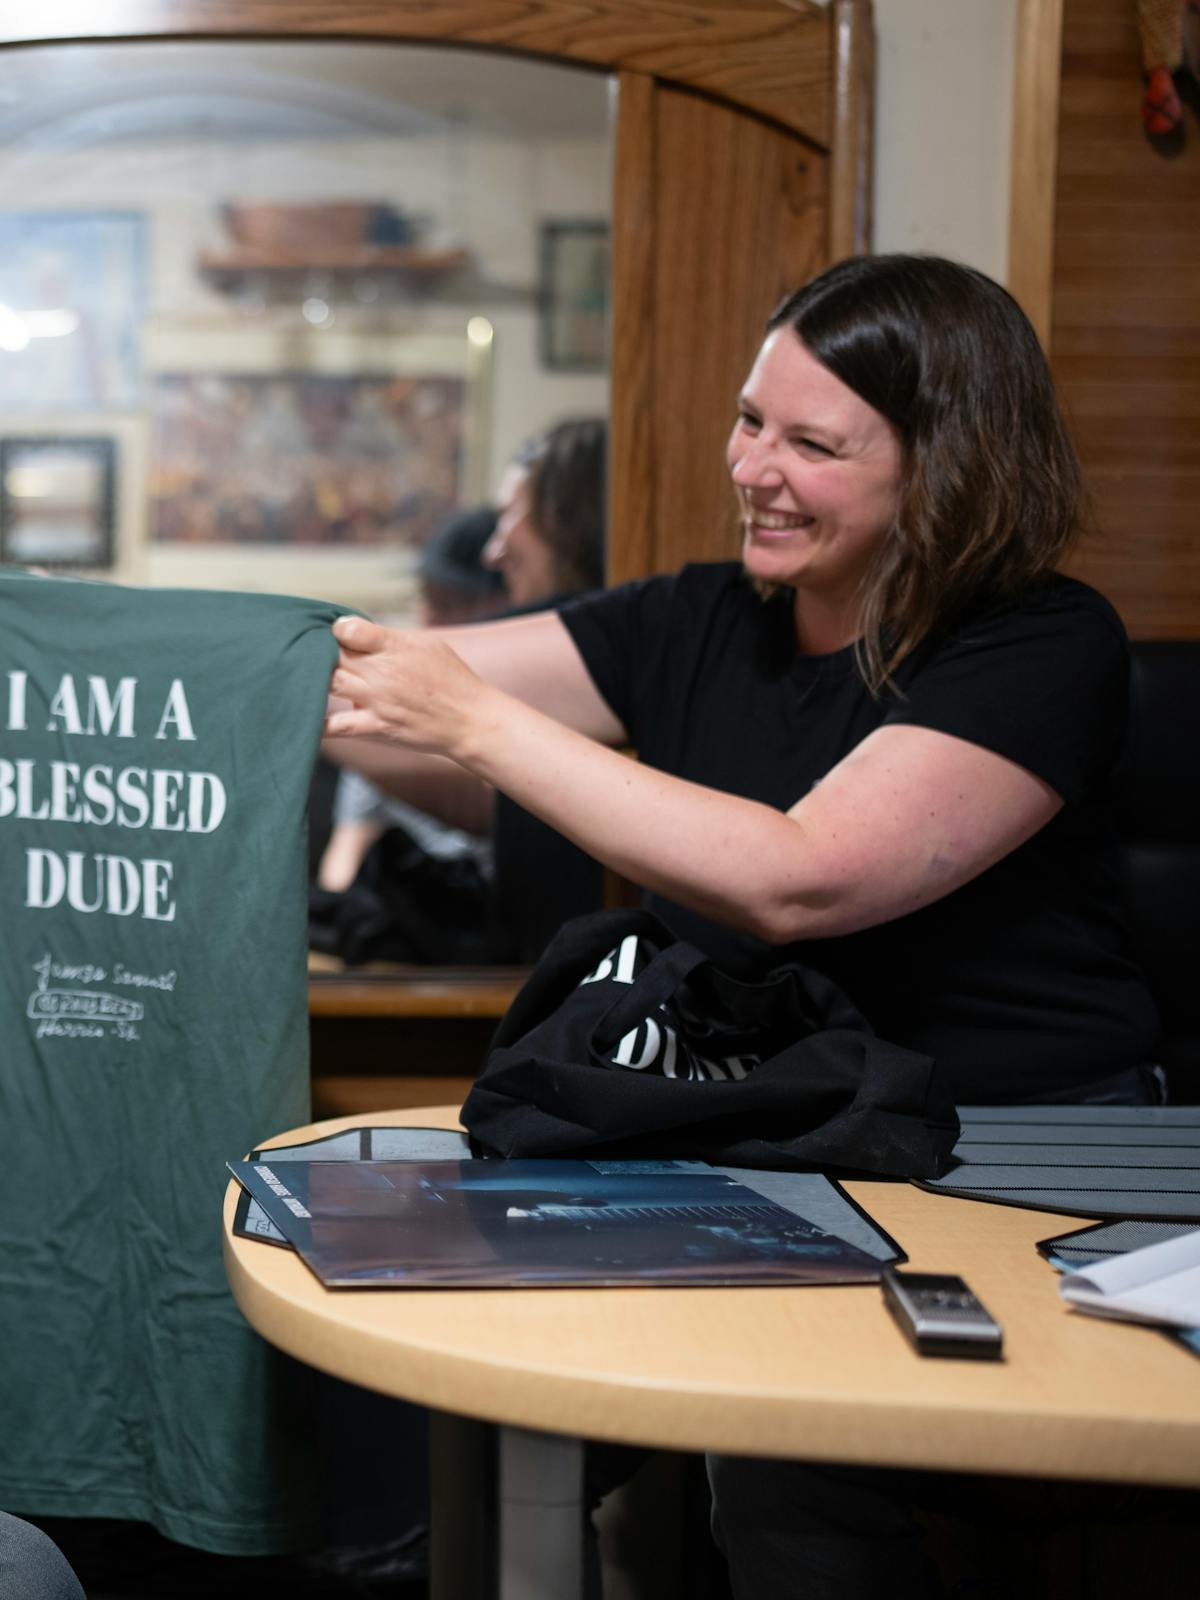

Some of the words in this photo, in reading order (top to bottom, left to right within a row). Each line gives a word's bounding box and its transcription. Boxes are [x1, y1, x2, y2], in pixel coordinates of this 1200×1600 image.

[7, 670, 28, 731] I
[46, 673, 139, 739] AM
[154, 677, 197, 741] A
[25, 848, 177, 922] DUDE
